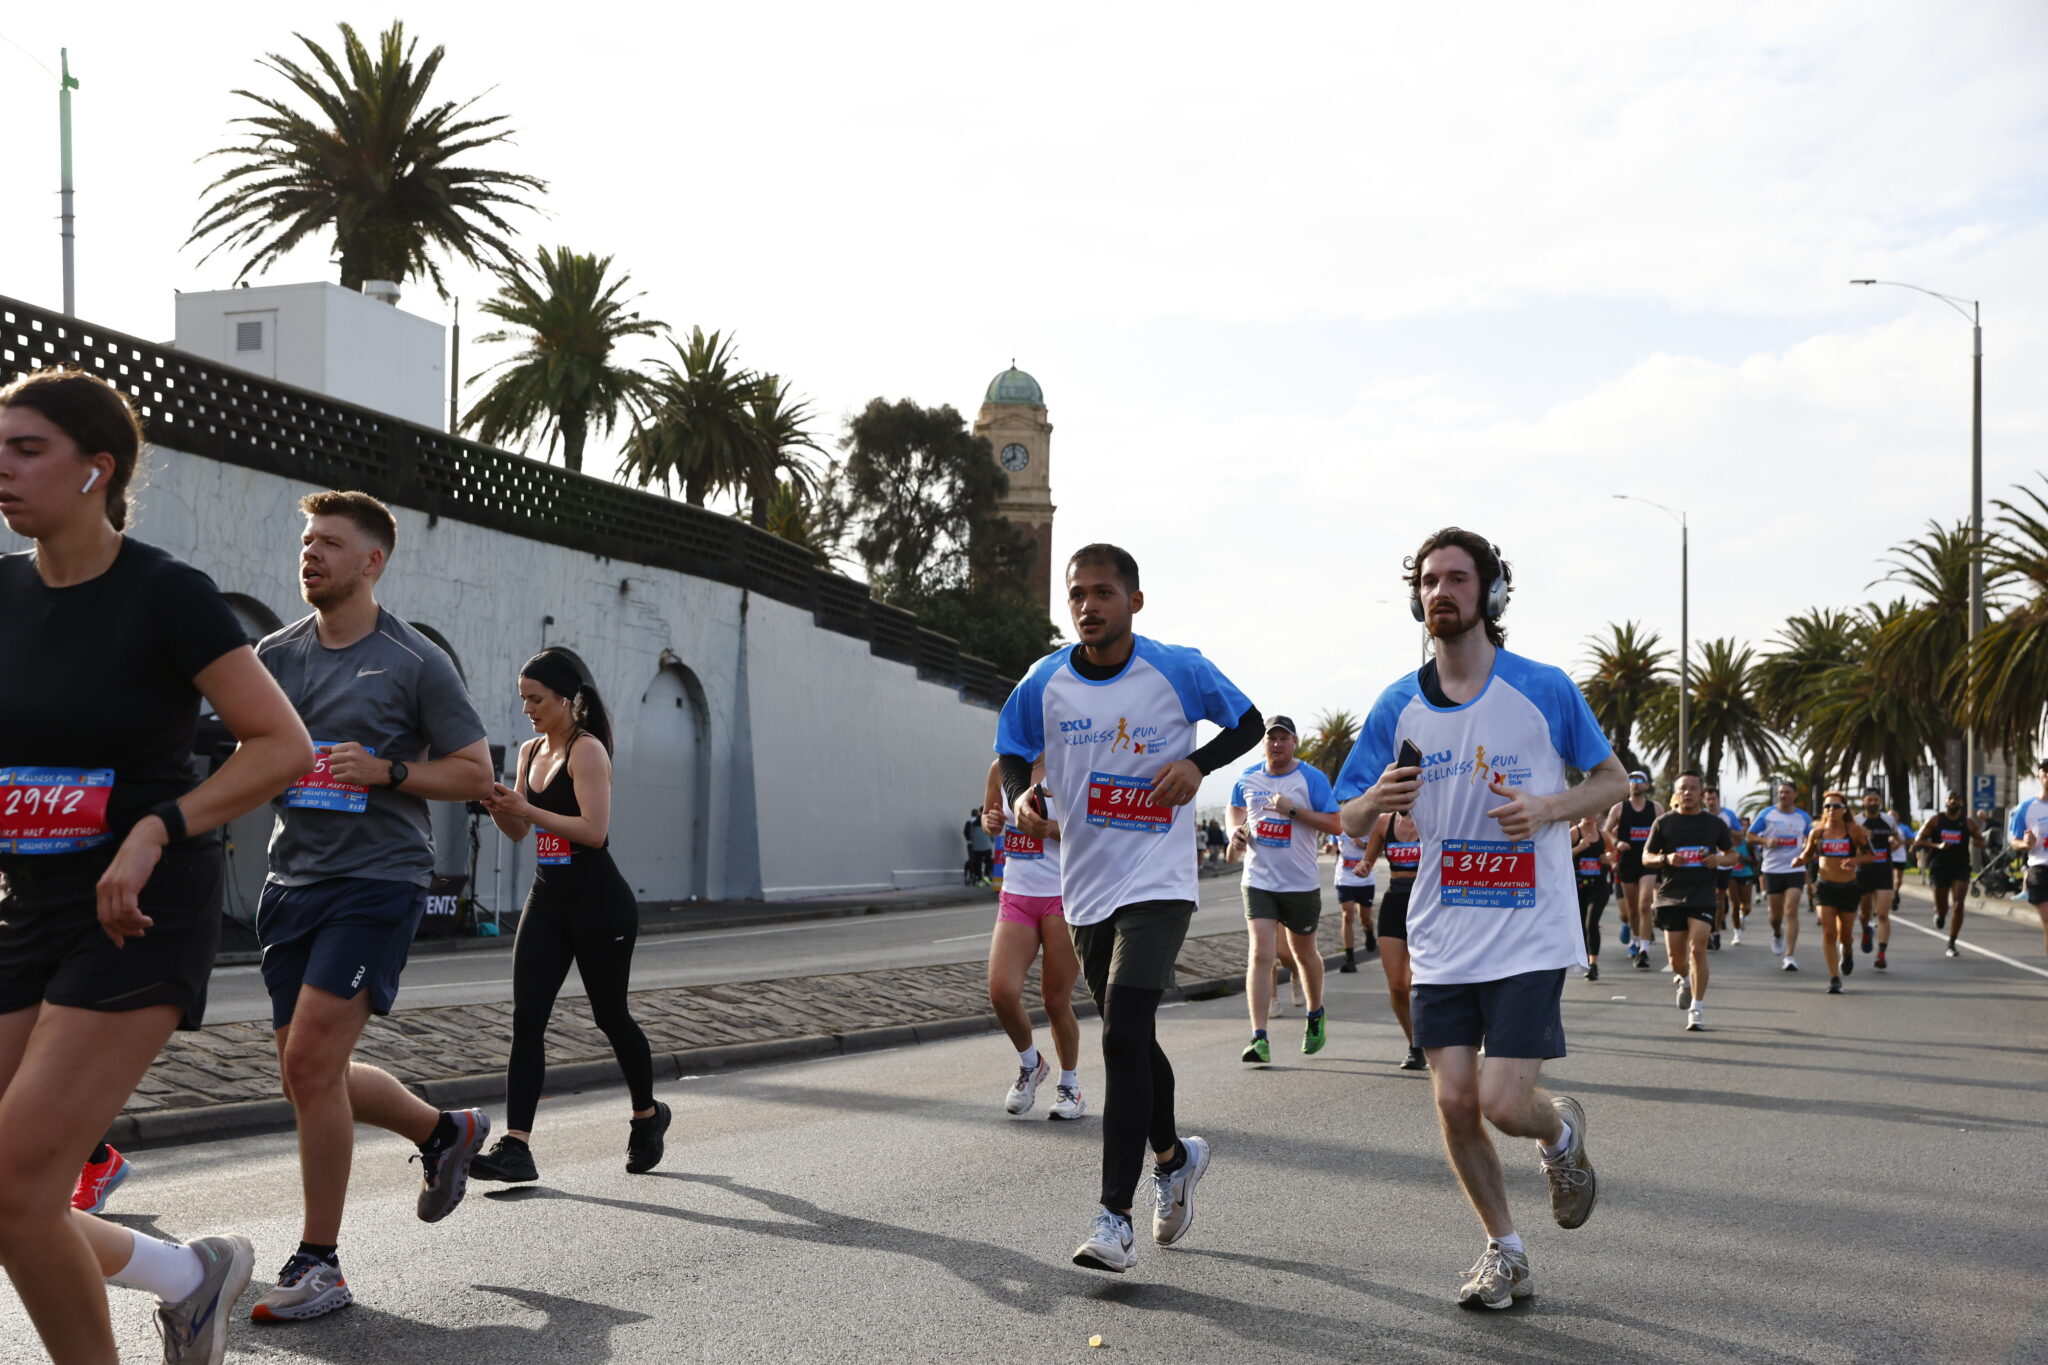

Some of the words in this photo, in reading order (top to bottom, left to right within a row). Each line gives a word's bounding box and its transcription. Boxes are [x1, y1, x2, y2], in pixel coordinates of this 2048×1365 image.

[1060, 719, 1091, 732] 2XU
[1132, 726, 1157, 739] RUN
[1491, 755, 1518, 768] RUN
[327, 784, 364, 792] MARATHON
[1978, 777, 1991, 792] P
[5, 784, 84, 816] 2942
[24, 828, 45, 836] HALF
[49, 827, 100, 837] MARATHON
[536, 836, 559, 851] 205
[1007, 834, 1034, 848] 4346
[1459, 852, 1518, 873] 3427
[426, 896, 458, 915] ENTS
[352, 965, 365, 988] 2XU
